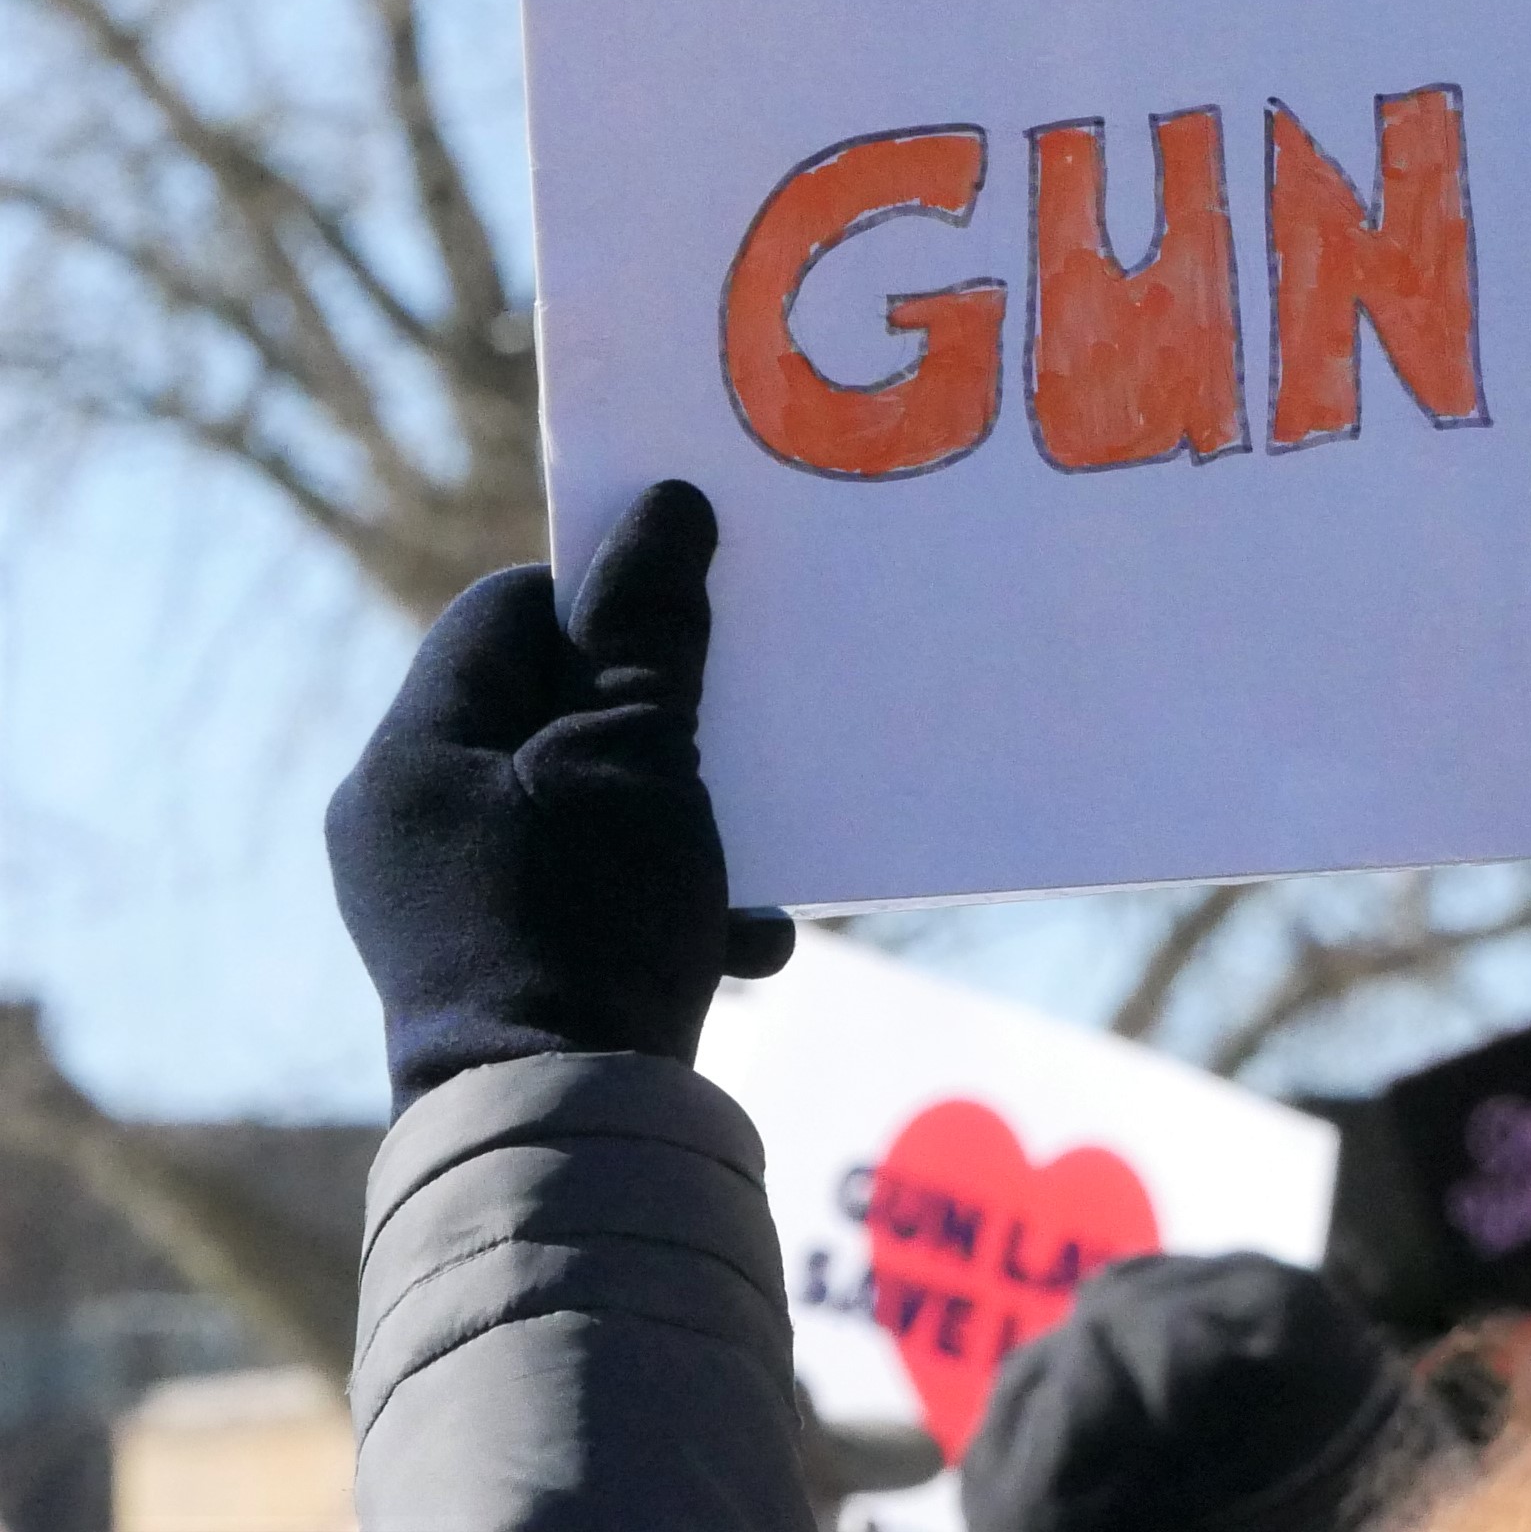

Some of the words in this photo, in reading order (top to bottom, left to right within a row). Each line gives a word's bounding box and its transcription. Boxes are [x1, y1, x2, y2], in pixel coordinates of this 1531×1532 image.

[719, 83, 1493, 482] GUN
[838, 1166, 982, 1261] GUN
[1002, 1220, 1110, 1292] LA
[805, 1250, 975, 1357] SAVE
